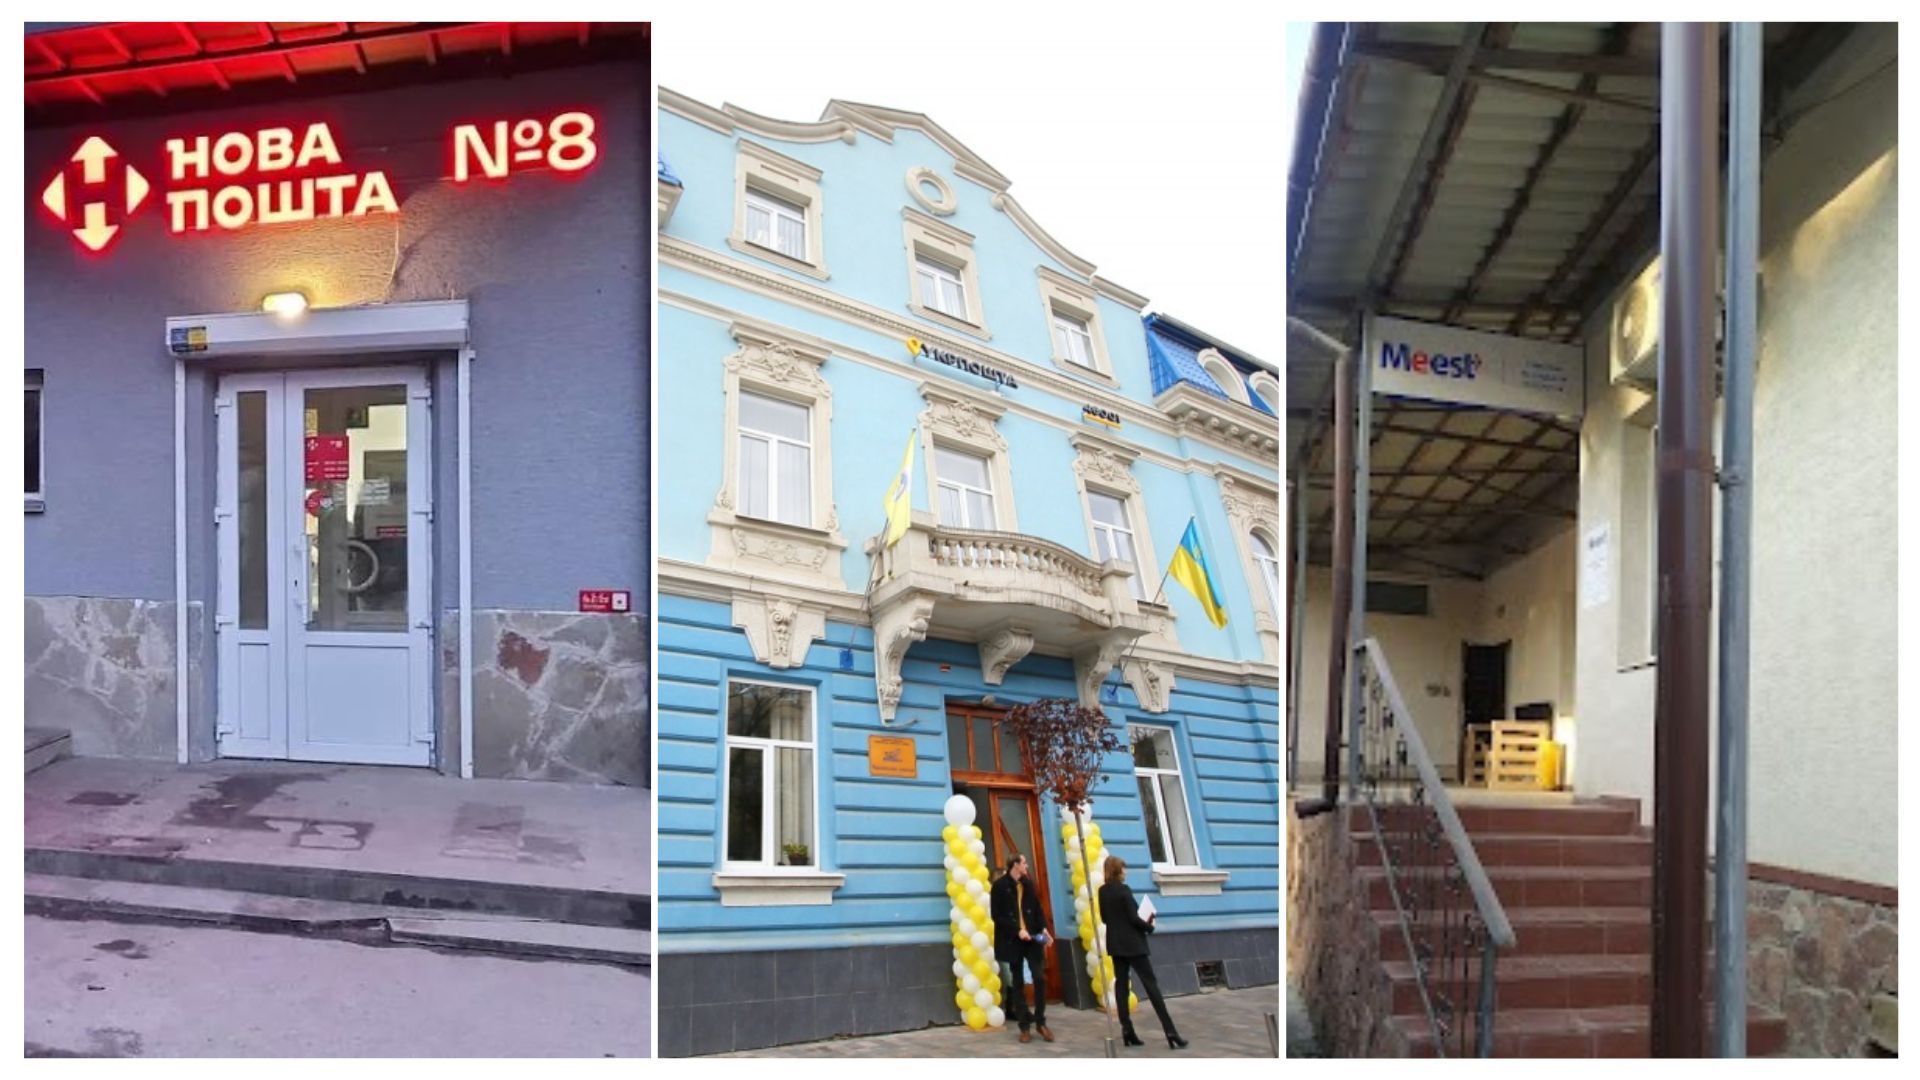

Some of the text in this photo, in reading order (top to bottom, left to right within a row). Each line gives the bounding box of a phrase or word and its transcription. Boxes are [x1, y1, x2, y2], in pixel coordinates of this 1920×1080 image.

[166, 122, 341, 179] НОВА
[453, 111, 597, 181] №8
[166, 171, 399, 233] ПОШТА
[920, 343, 1019, 390] УКРПОШТА
[1380, 341, 1476, 379] Meest
